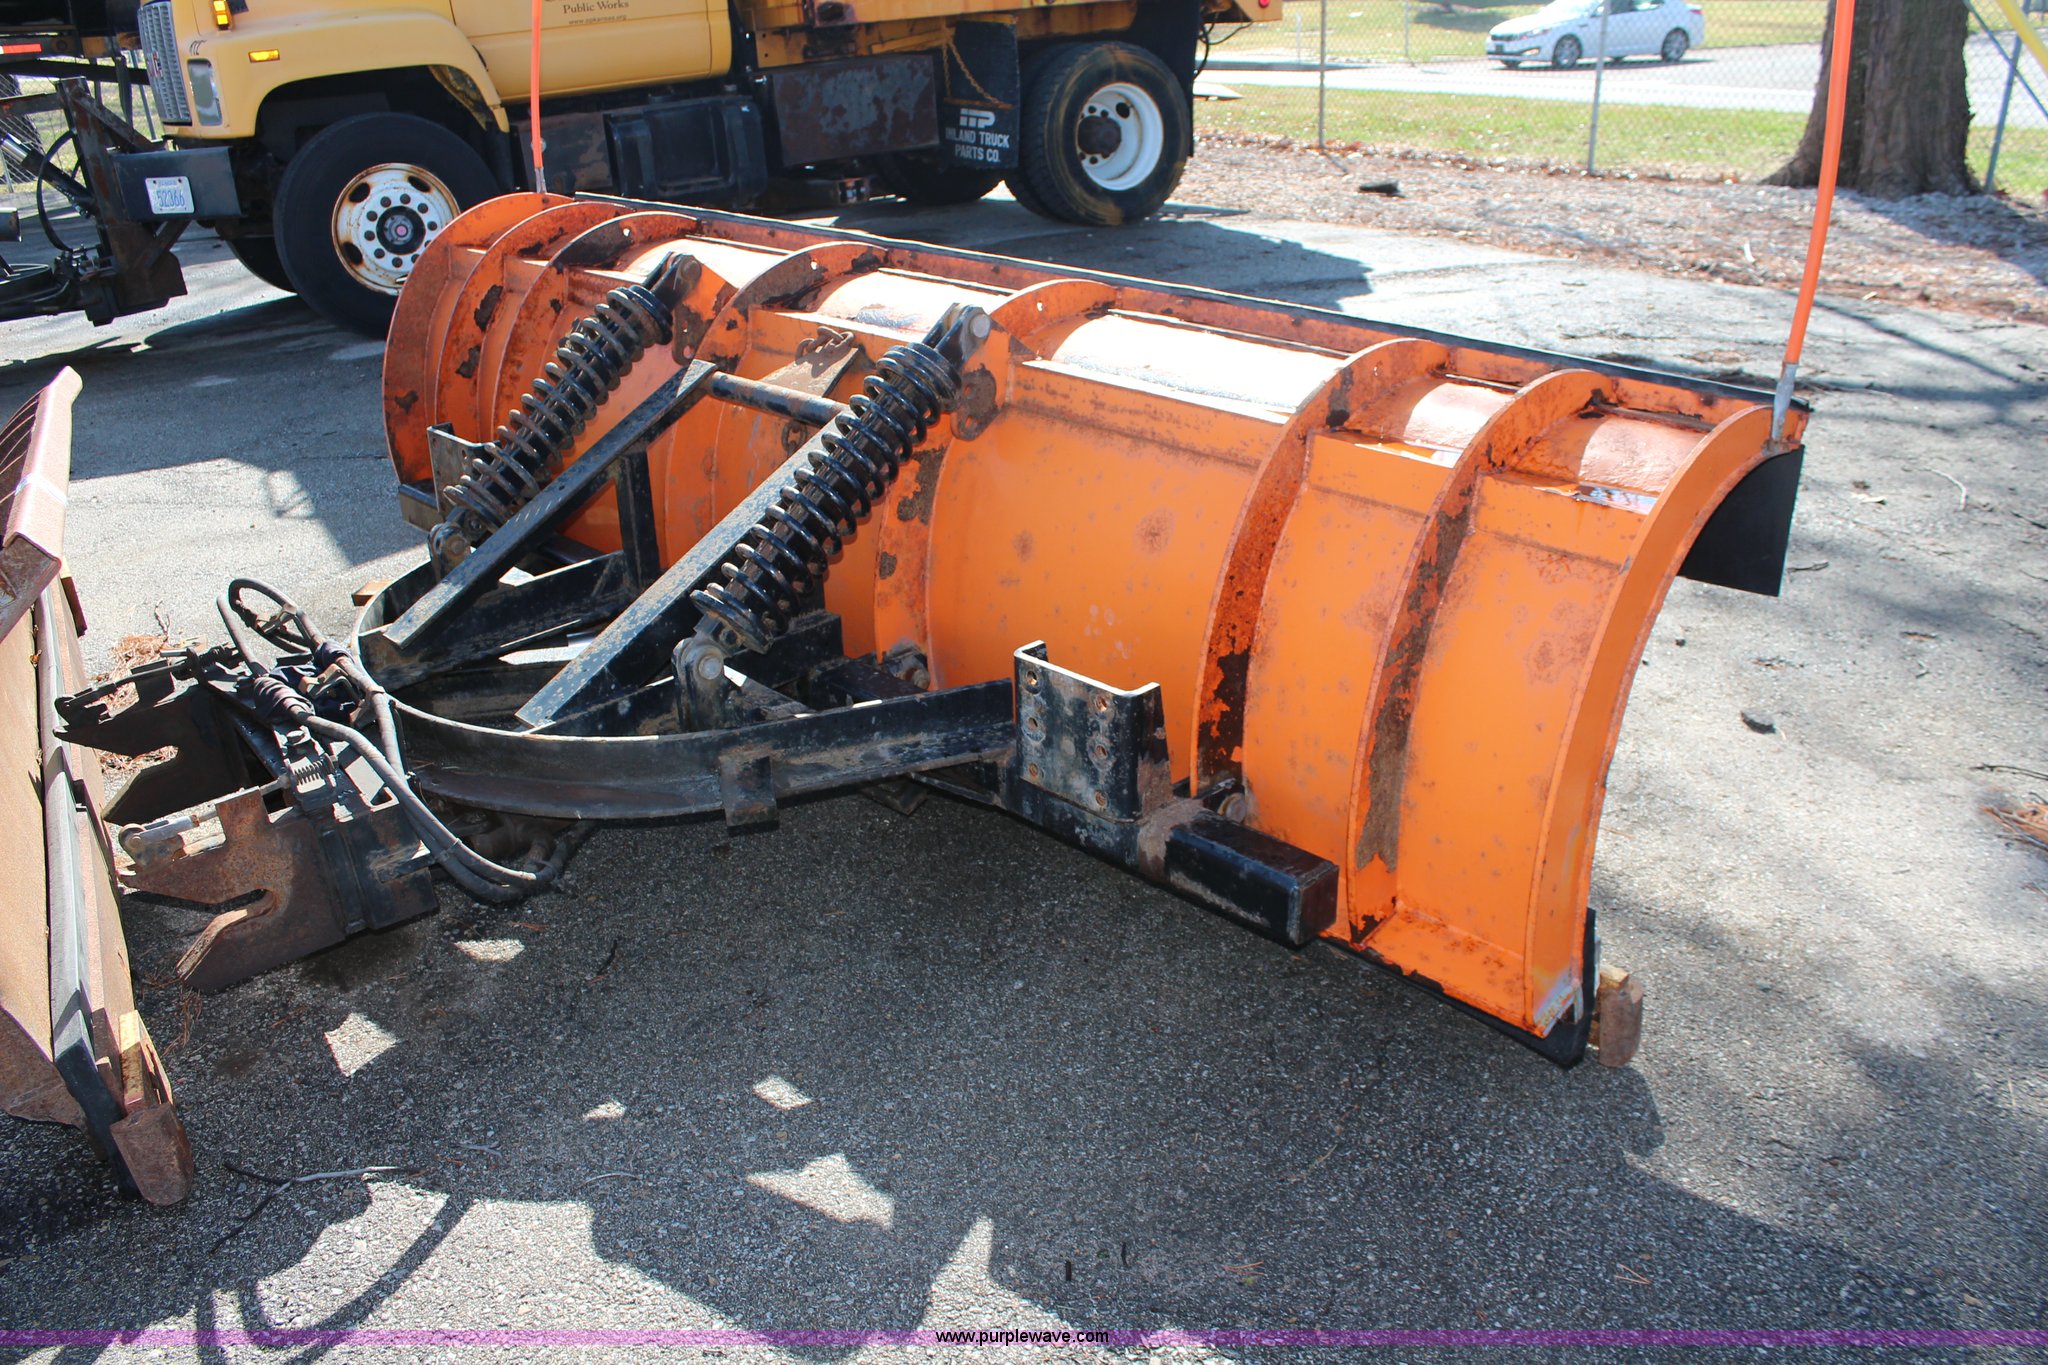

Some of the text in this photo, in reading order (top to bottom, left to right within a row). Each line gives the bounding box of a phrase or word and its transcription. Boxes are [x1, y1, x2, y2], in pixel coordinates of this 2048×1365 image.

[563, 0, 629, 14] Public Works
[979, 131, 1010, 148] TRUCK
[955, 143, 984, 160] PARTS
[156, 189, 186, 207] 52366
